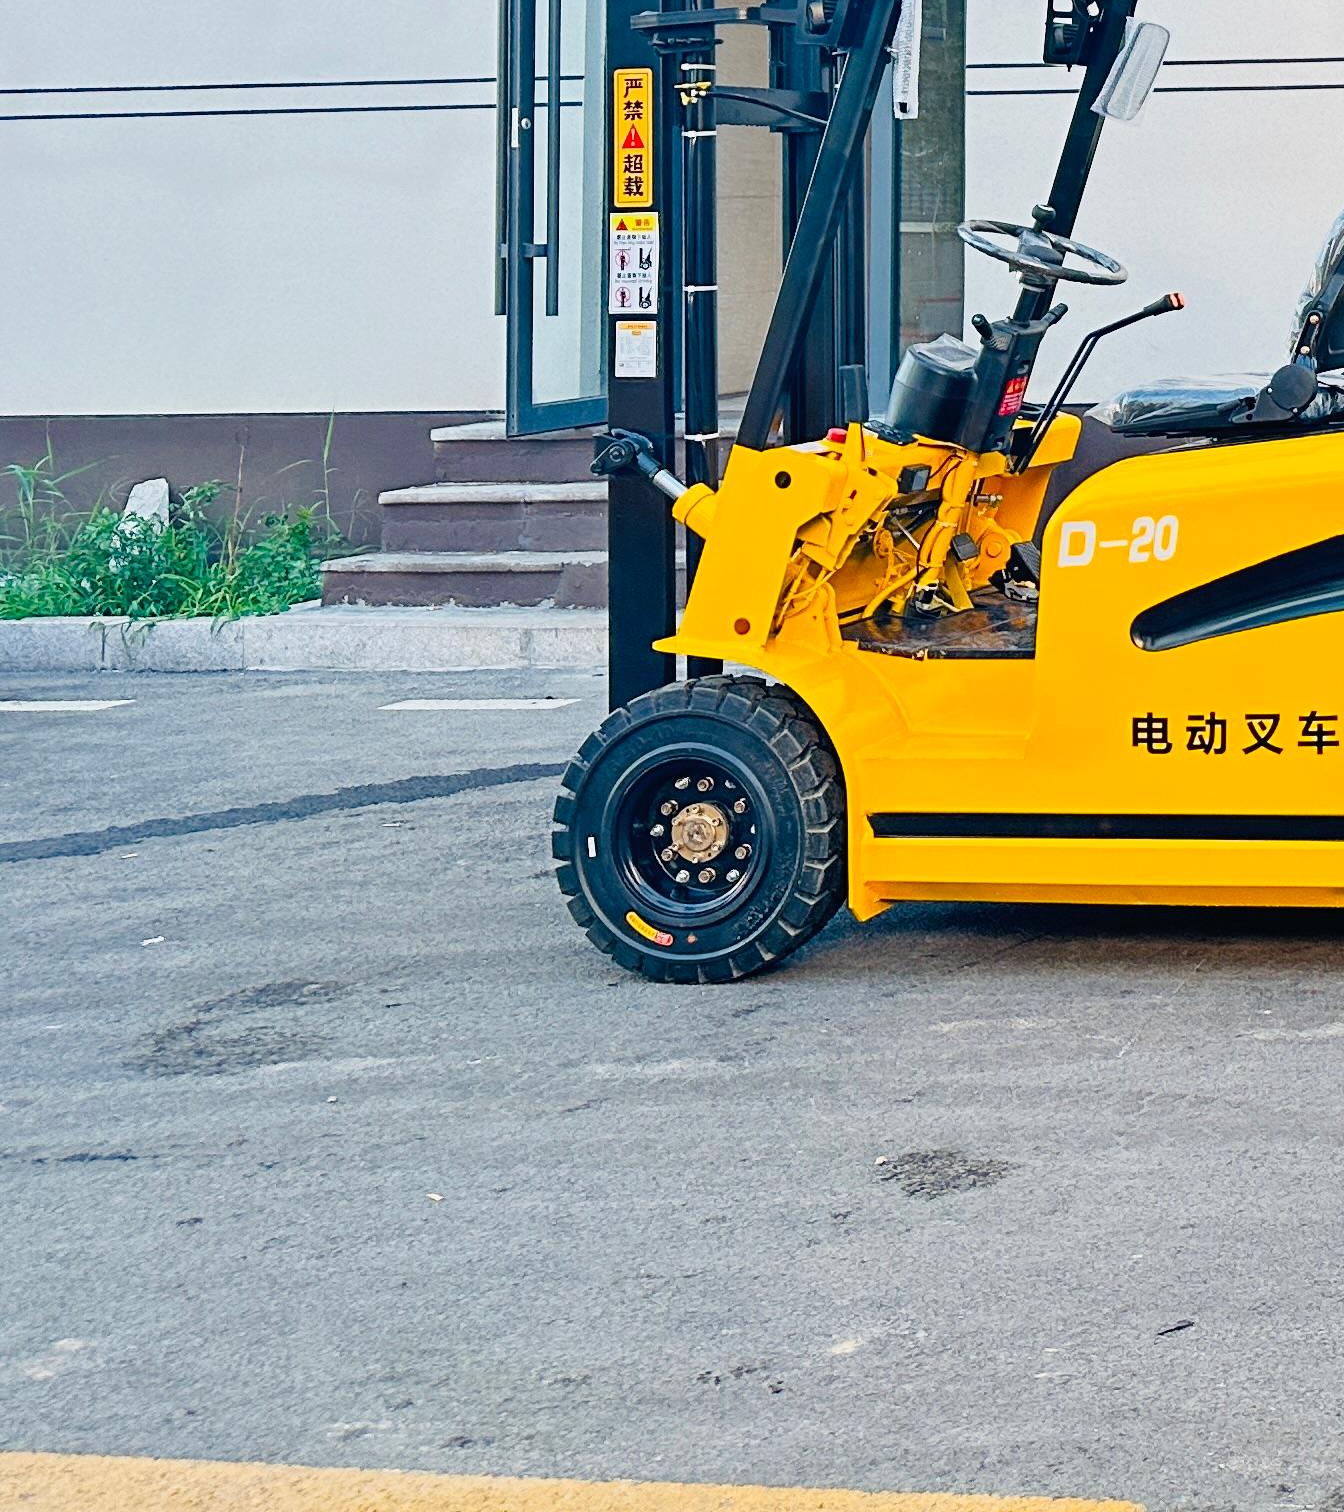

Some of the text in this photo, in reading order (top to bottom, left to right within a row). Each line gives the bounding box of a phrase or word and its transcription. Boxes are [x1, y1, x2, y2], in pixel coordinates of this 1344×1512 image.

[1058, 515, 1179, 568] D-20
[1131, 710, 1340, 755] 电动叉车
